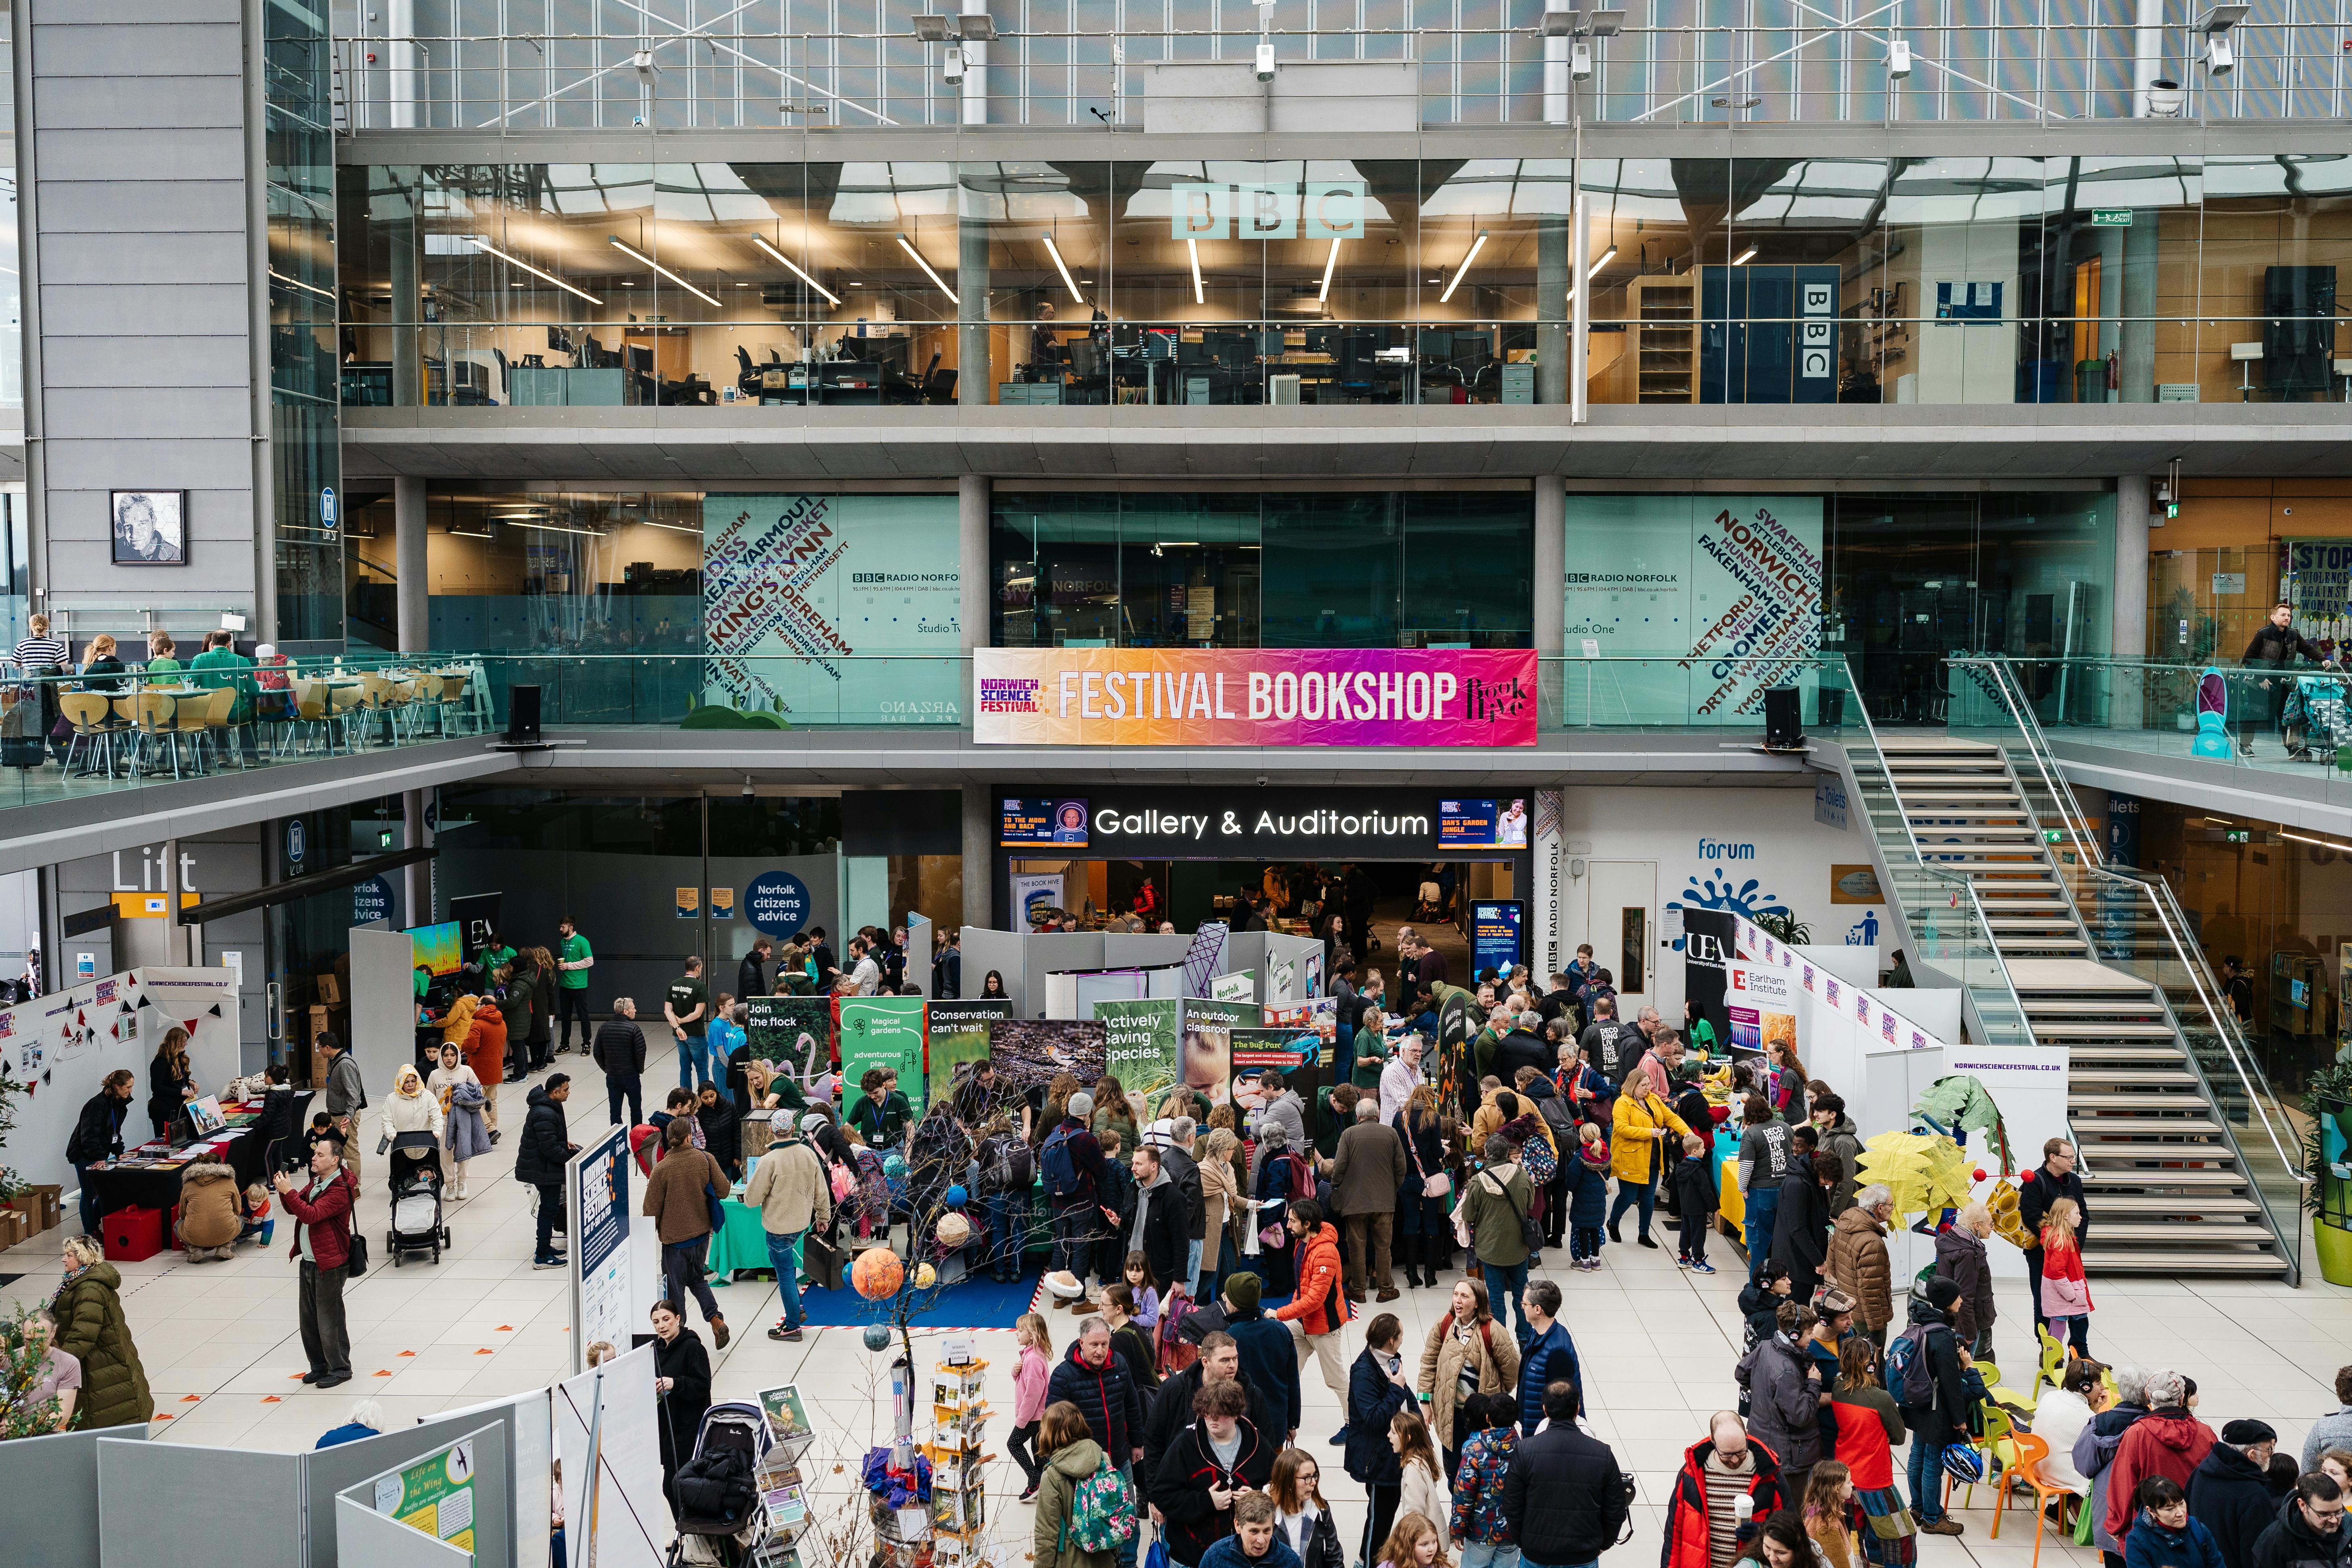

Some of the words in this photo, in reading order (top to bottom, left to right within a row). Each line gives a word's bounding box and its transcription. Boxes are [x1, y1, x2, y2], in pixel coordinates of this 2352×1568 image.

[1178, 186, 1359, 235] BBC
[1804, 287, 1830, 375] BBC
[772, 498, 829, 558] MARKET
[706, 536, 748, 578] DISS
[1714, 509, 1817, 607] NORWICH
[1749, 522, 1822, 592] ATTLEBOROUGH
[2299, 546, 2352, 569] STOP
[791, 548, 829, 586] STALHAM
[798, 540, 849, 593] HETHERSETT
[1697, 534, 1774, 607] FAKENHAM
[1720, 537, 1796, 609] HUNSTANTON
[709, 576, 779, 647] KING'S
[775, 521, 834, 581] LYNN
[853, 573, 885, 582] BBC
[2302, 571, 2348, 584] VIOLENCE
[2301, 585, 2348, 598] AGAINST
[2301, 599, 2345, 612] WOMEN!
[723, 595, 781, 655] BLAKENEY
[779, 584, 854, 656] DEREHAM
[918, 623, 949, 633] Studio
[1725, 603, 1764, 641] WELLS
[780, 603, 831, 655] HEACHAM
[1592, 624, 1614, 633] One
[1677, 594, 1753, 670] THETFORD
[774, 626, 812, 665] MARHAM
[1711, 603, 1787, 680] CROMER
[1734, 605, 1807, 677] WALSHAM
[1752, 615, 1814, 681] MUNDESLEY
[981, 678, 1039, 690] NORWICH
[1466, 677, 1527, 700] Book
[981, 690, 1032, 701] SCIENCE
[1059, 671, 1236, 720] FESTIVAL
[1248, 671, 1458, 721] BOOKSHOP
[981, 701, 1039, 712] FESTIVAL
[1824, 786, 1846, 810] Toilets
[1095, 809, 1208, 839] Gallery
[1221, 811, 1242, 834] &
[1254, 810, 1428, 835] Auditorium
[1535, 811, 1559, 837] NORWICH
[1539, 823, 1559, 842] FAKENHAM
[1699, 838, 1754, 859] forum
[113, 846, 196, 892] Lift
[1550, 842, 1558, 896] NORFOLK
[758, 885, 795, 894] Norfolk
[754, 897, 800, 908] citizens
[757, 910, 797, 921] advice
[1549, 900, 1557, 936] RADIO
[1686, 932, 1726, 963] UEA
[1548, 941, 1558, 973] BBC
[1687, 959, 1705, 967] University
[1803, 964, 1814, 975] NORWICH
[96, 979, 116, 992] NORWICH
[1749, 972, 1785, 986] Earlham
[1803, 972, 1813, 984] SCIENCE
[1827, 978, 1839, 990] NORWICH
[96, 987, 114, 1000] SCIENCE
[1217, 983, 1239, 999] Norfolk
[1230, 991, 1252, 1002] Composters
[1750, 982, 1787, 996] Institute
[1827, 986, 1837, 1000] SCIENCE
[96, 995, 117, 1007] FESTIVAL
[1858, 994, 1868, 1007] NORWICH
[749, 1004, 771, 1014] Join
[931, 1010, 1004, 1020] Conservation
[1186, 1009, 1199, 1019] An
[1201, 1010, 1240, 1022] outdoor
[1858, 1003, 1868, 1016] SCIENCE
[750, 1017, 766, 1026] the
[770, 1017, 796, 1026] flock
[871, 1017, 900, 1028] Magical
[1102, 1013, 1161, 1030] Actively
[1883, 1011, 1896, 1026] NORWICH
[871, 1026, 901, 1035] gardens
[931, 1023, 957, 1033] can't
[960, 1022, 983, 1032] wait
[1883, 1020, 1894, 1035] SCIENCE
[1105, 1030, 1151, 1046] Saving
[1250, 1041, 1263, 1049] Bug
[1105, 1046, 1160, 1064] Species
[1954, 1063, 2061, 1071] NORWICHSCIENCEFESTIVAL.CO.UK
[1762, 1126, 1784, 1137] DECO
[1766, 1133, 1785, 1144] DING
[616, 1141, 625, 1156] forum
[1769, 1141, 1780, 1151] LIV
[1770, 1148, 1784, 1158] ING
[1771, 1156, 1786, 1165] SYS
[583, 1150, 610, 1189] NORWICH
[583, 1170, 607, 1208] SCIENCE
[584, 1186, 611, 1227] FESTIVAL
[410, 1465, 426, 1482] Life
[427, 1462, 437, 1470] on
[410, 1484, 421, 1498] the
[423, 1477, 442, 1490] Wing
[404, 1500, 419, 1513] Swifts
[427, 1487, 447, 1501] amazing!
